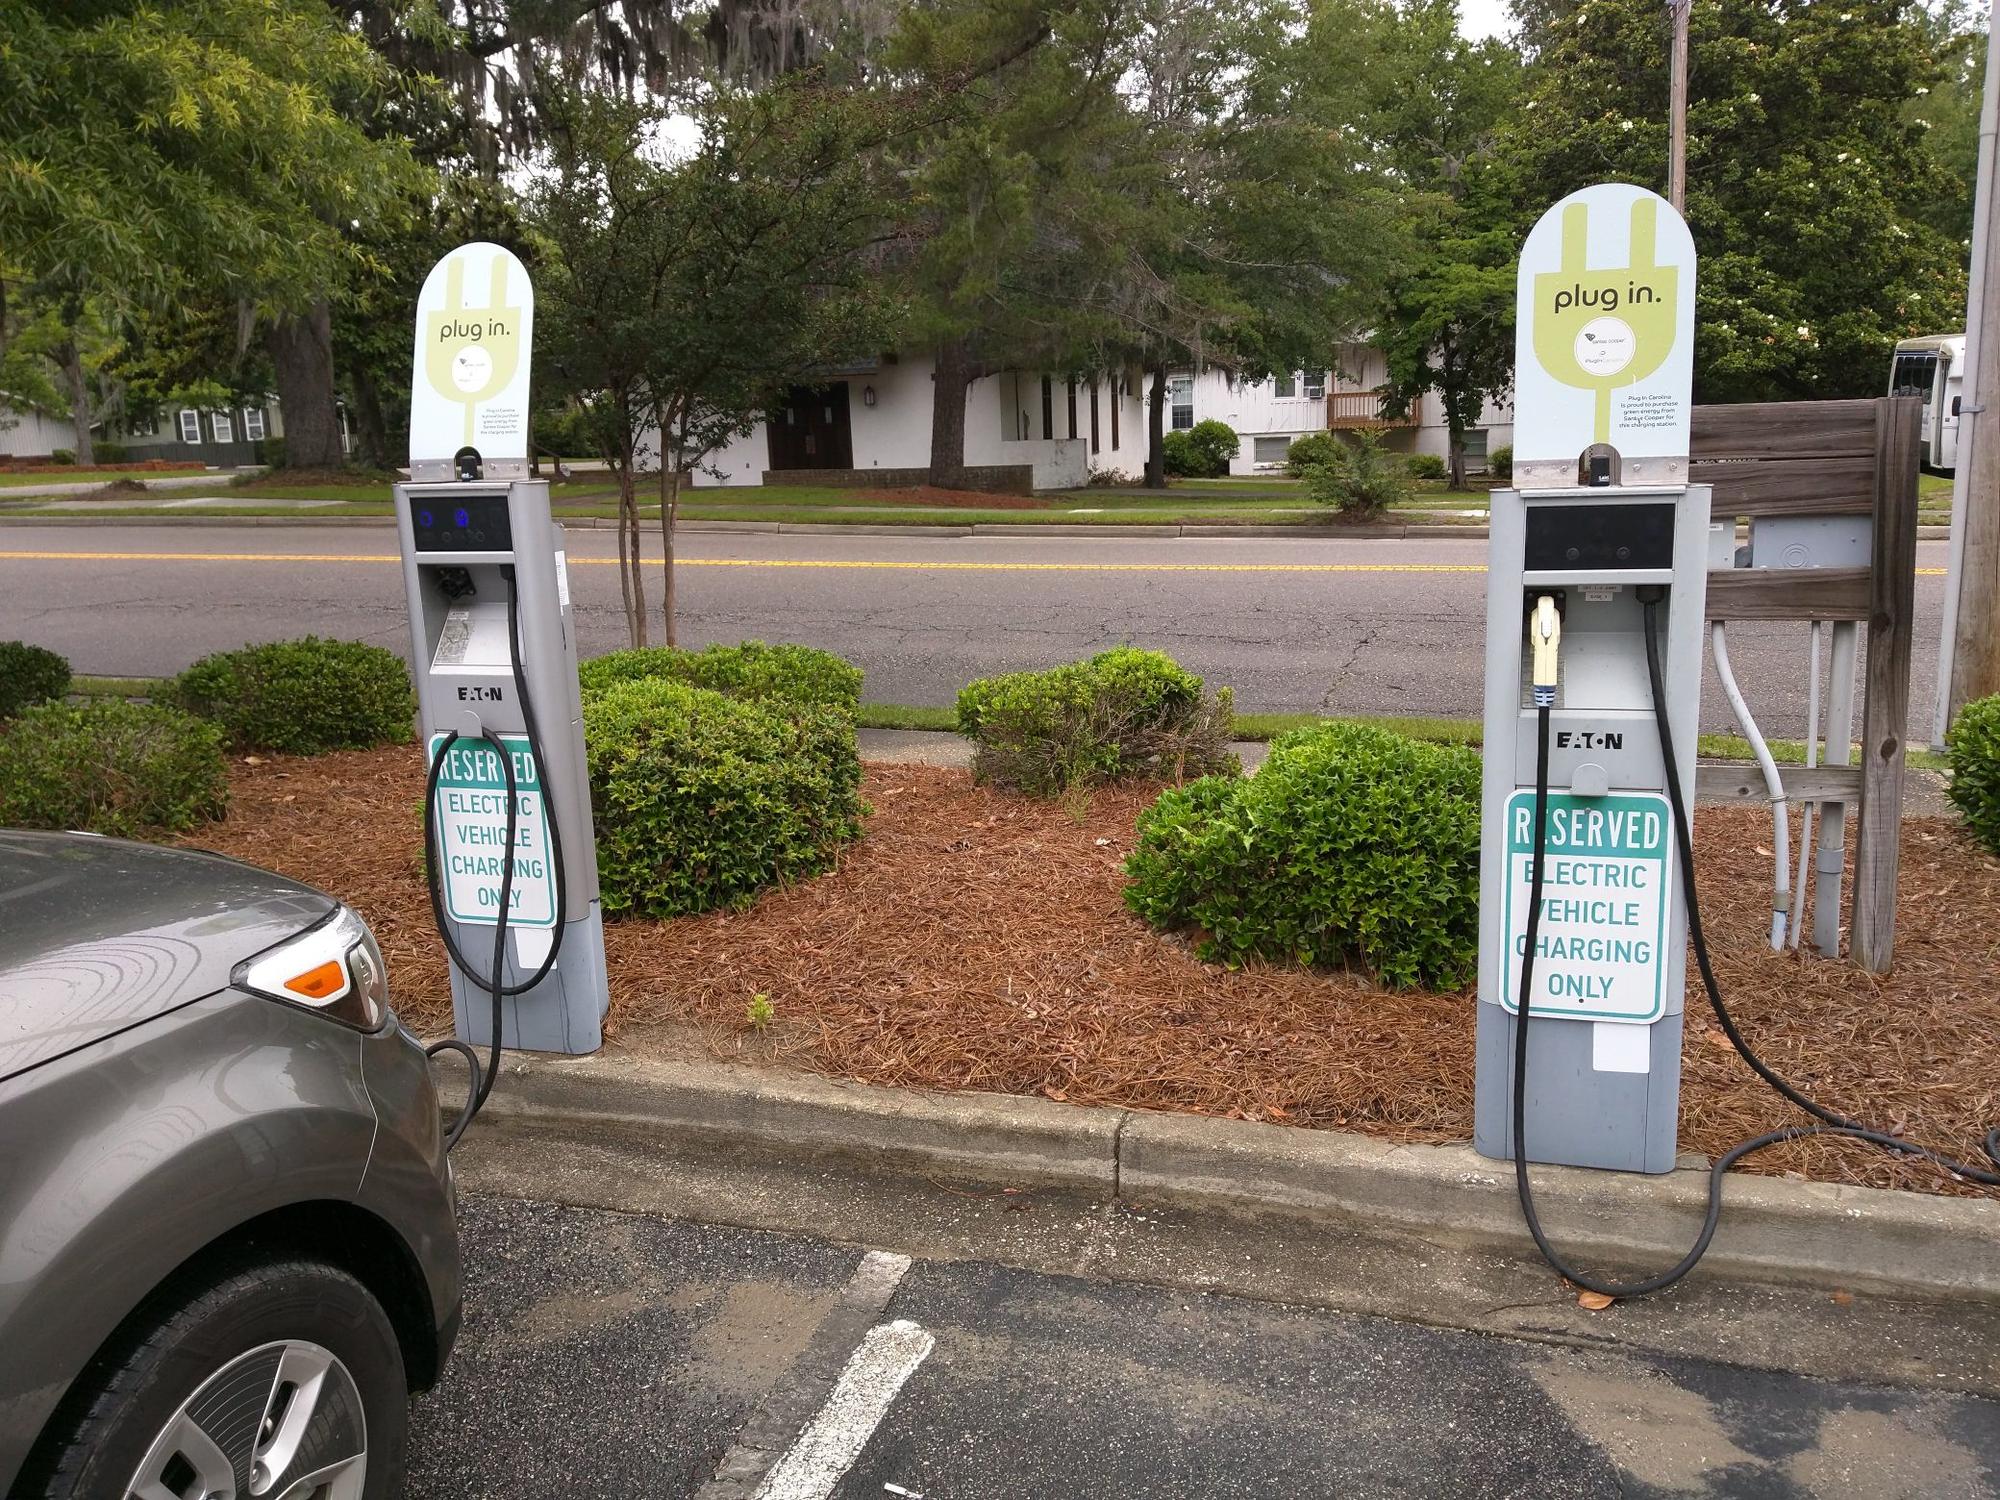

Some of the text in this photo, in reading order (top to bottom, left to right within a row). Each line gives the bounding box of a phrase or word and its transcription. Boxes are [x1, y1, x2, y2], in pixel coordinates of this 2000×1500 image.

[1554, 280, 1662, 314] plug in.
[440, 318, 510, 342] plug in.
[457, 686, 503, 701] EATON
[1556, 731, 1623, 750] EATON
[1515, 807, 1660, 849] RSERVED
[477, 886, 522, 908] ONY
[1548, 973, 1614, 999] ONLY
